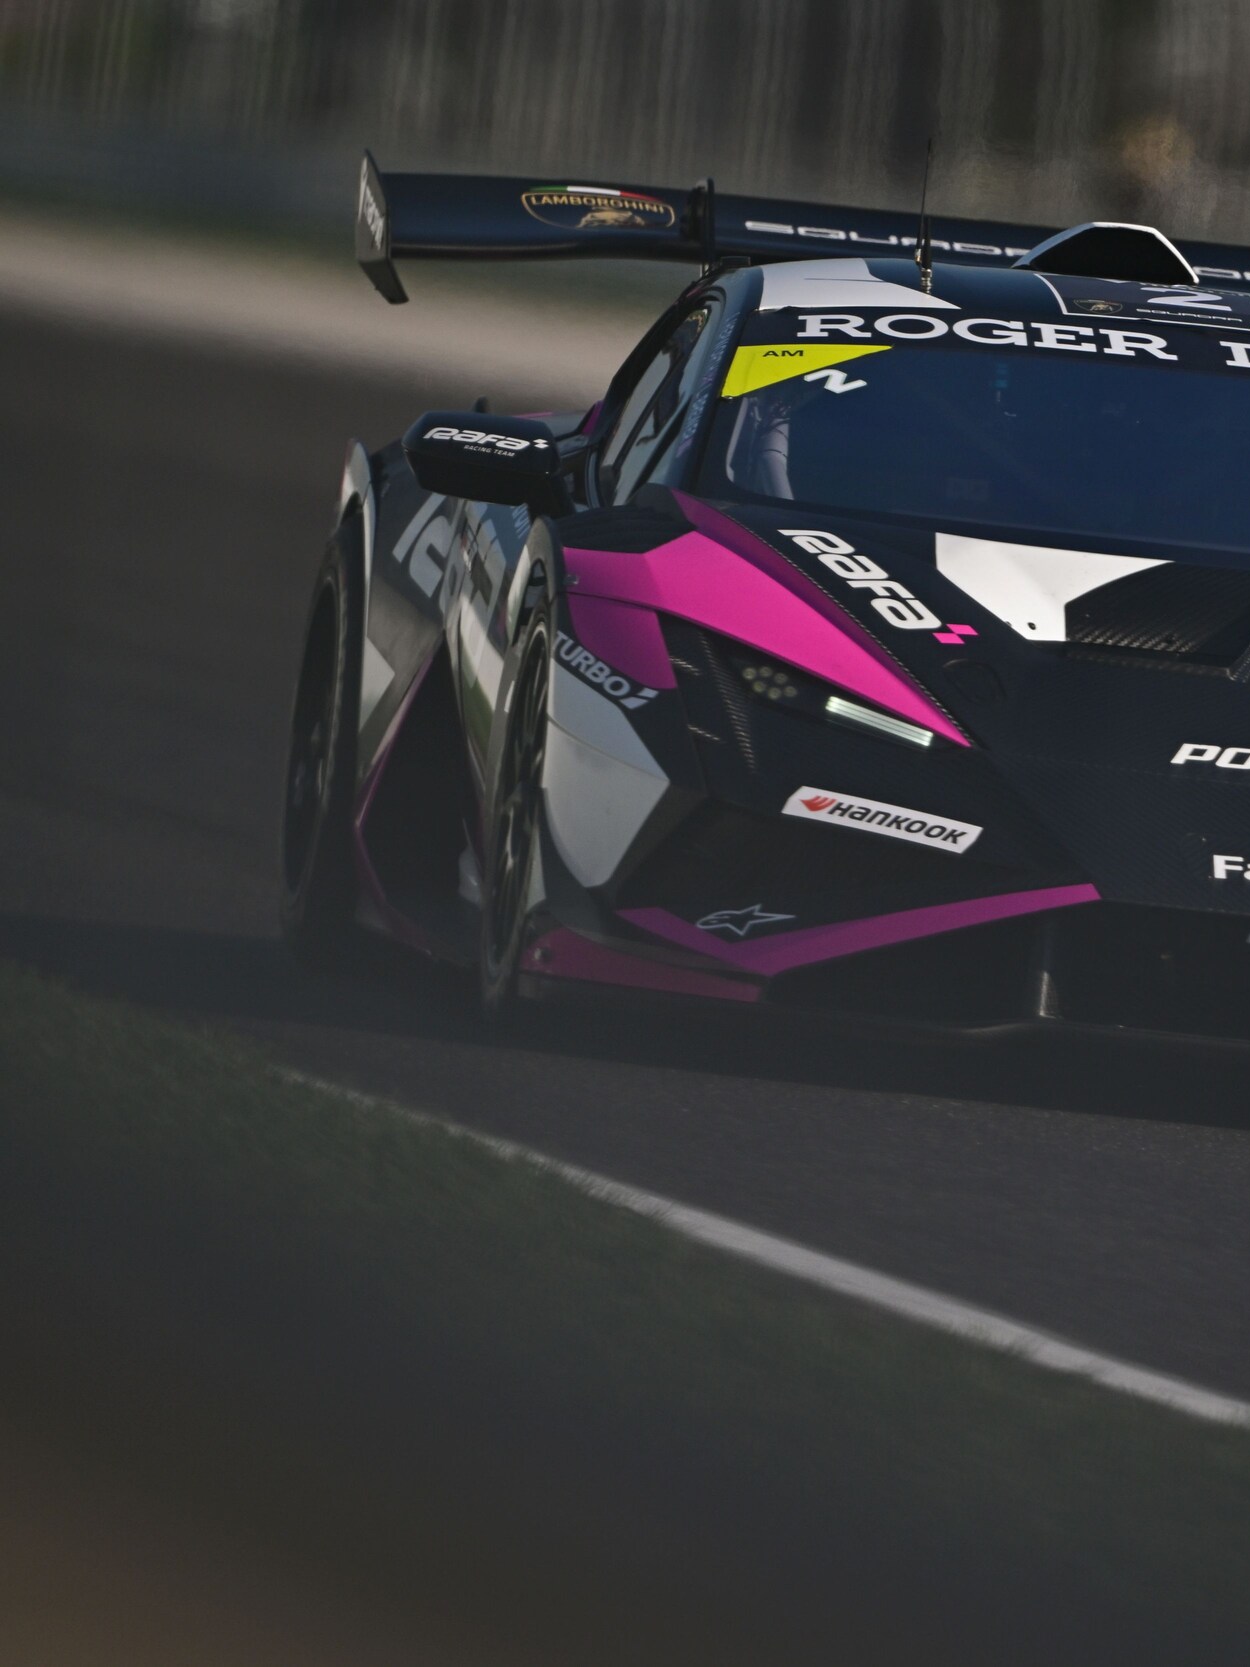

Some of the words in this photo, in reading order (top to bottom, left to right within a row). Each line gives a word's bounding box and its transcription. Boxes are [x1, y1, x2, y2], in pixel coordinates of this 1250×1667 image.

[531, 194, 665, 214] LAMBORGHINI
[797, 314, 1178, 361] ROGER
[804, 369, 867, 394] 2
[464, 444, 492, 454] RACING
[493, 448, 515, 457] TEAM
